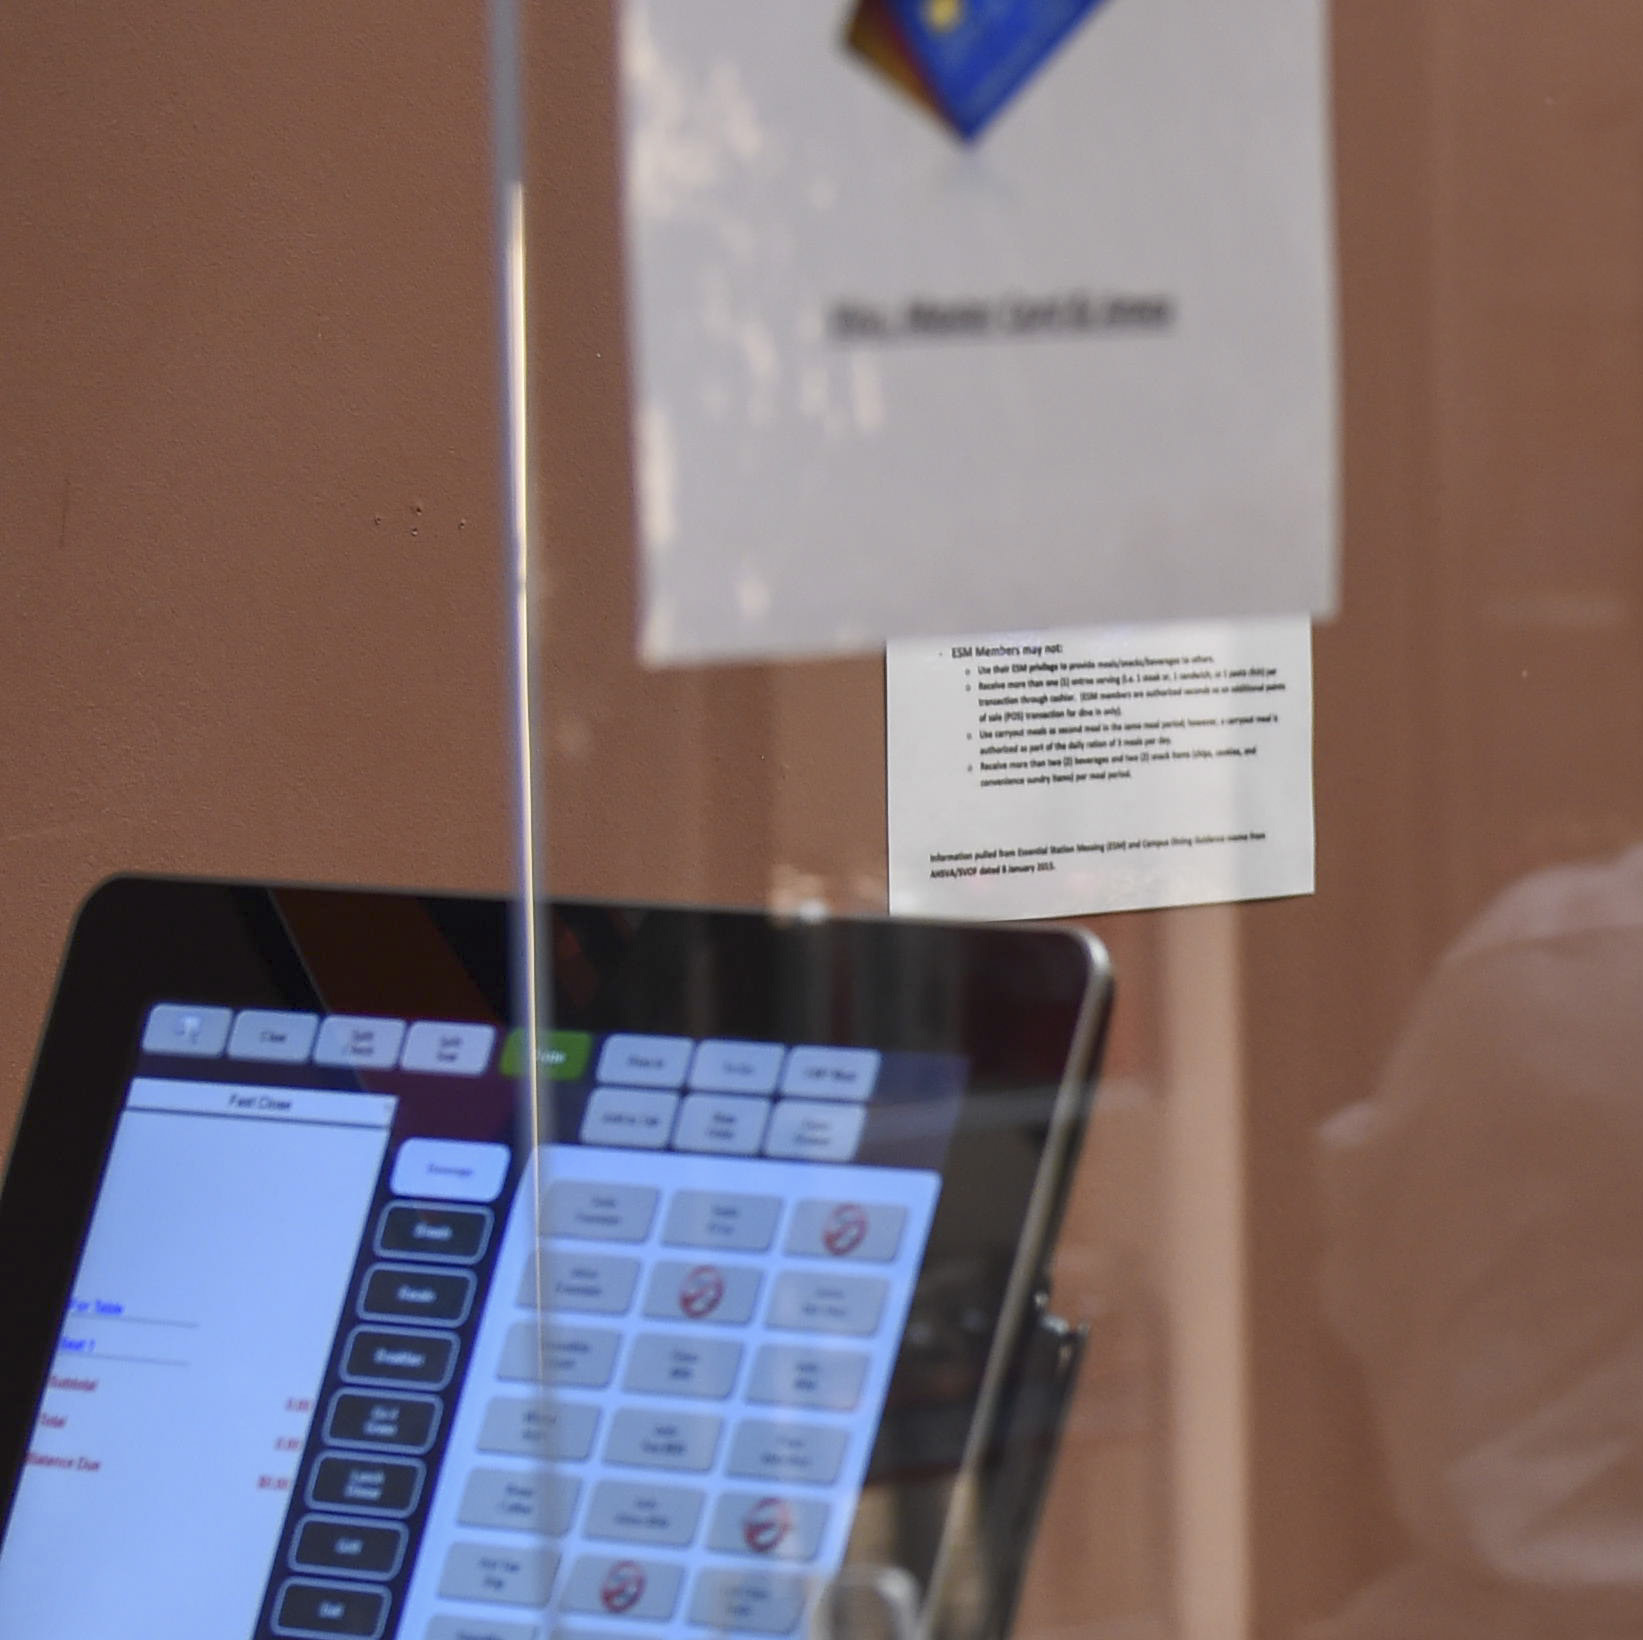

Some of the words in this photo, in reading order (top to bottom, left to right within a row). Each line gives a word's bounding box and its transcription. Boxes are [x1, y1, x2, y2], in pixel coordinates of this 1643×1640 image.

[952, 647, 973, 659] ESM
[976, 646, 1021, 657] Members
[1023, 646, 1043, 657] may
[1045, 644, 1063, 654] not:
